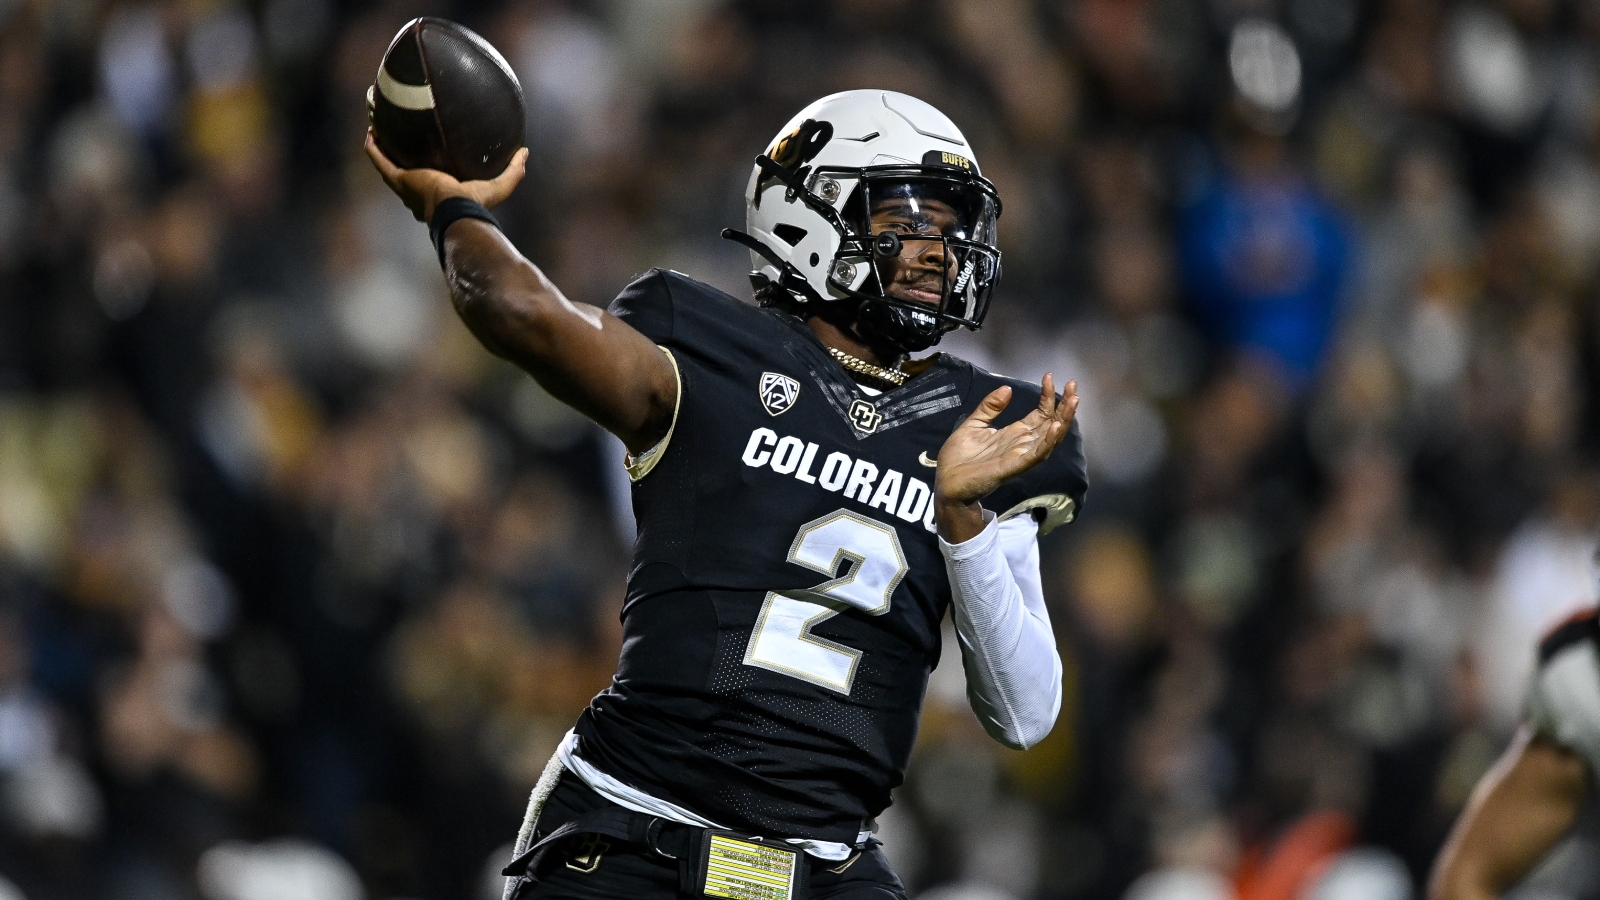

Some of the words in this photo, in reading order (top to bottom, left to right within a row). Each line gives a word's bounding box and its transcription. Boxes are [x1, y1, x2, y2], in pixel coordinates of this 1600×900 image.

[941, 151, 969, 169] BUFFS
[762, 374, 798, 405] PAC
[766, 391, 786, 410] 12
[849, 399, 882, 433] CU
[742, 507, 910, 696] 2
